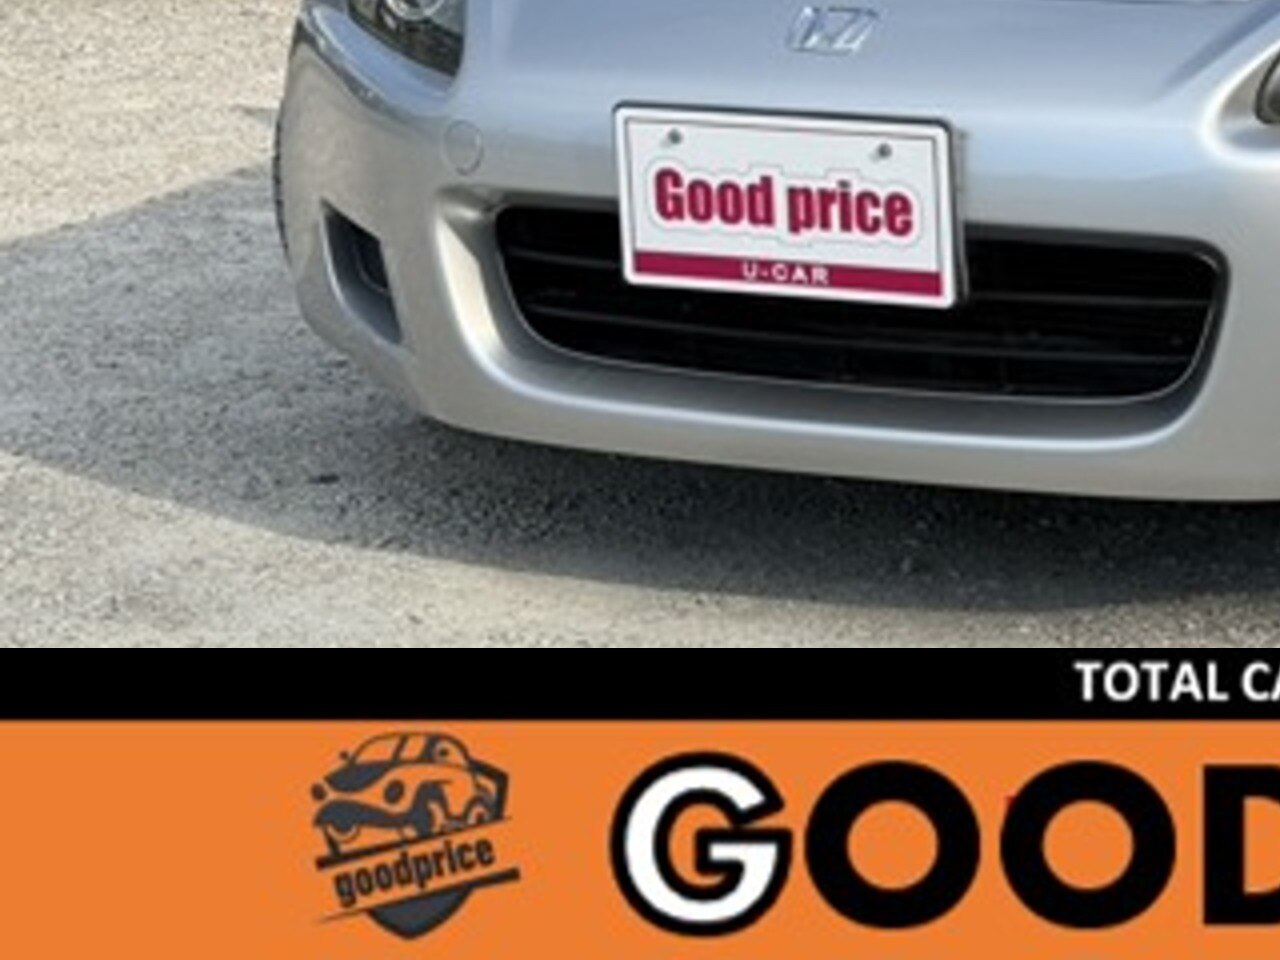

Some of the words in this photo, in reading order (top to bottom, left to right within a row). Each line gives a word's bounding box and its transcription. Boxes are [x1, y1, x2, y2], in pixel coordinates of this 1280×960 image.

[654, 167, 776, 227] Good
[786, 178, 914, 237] price
[742, 262, 830, 286] U-CAR
